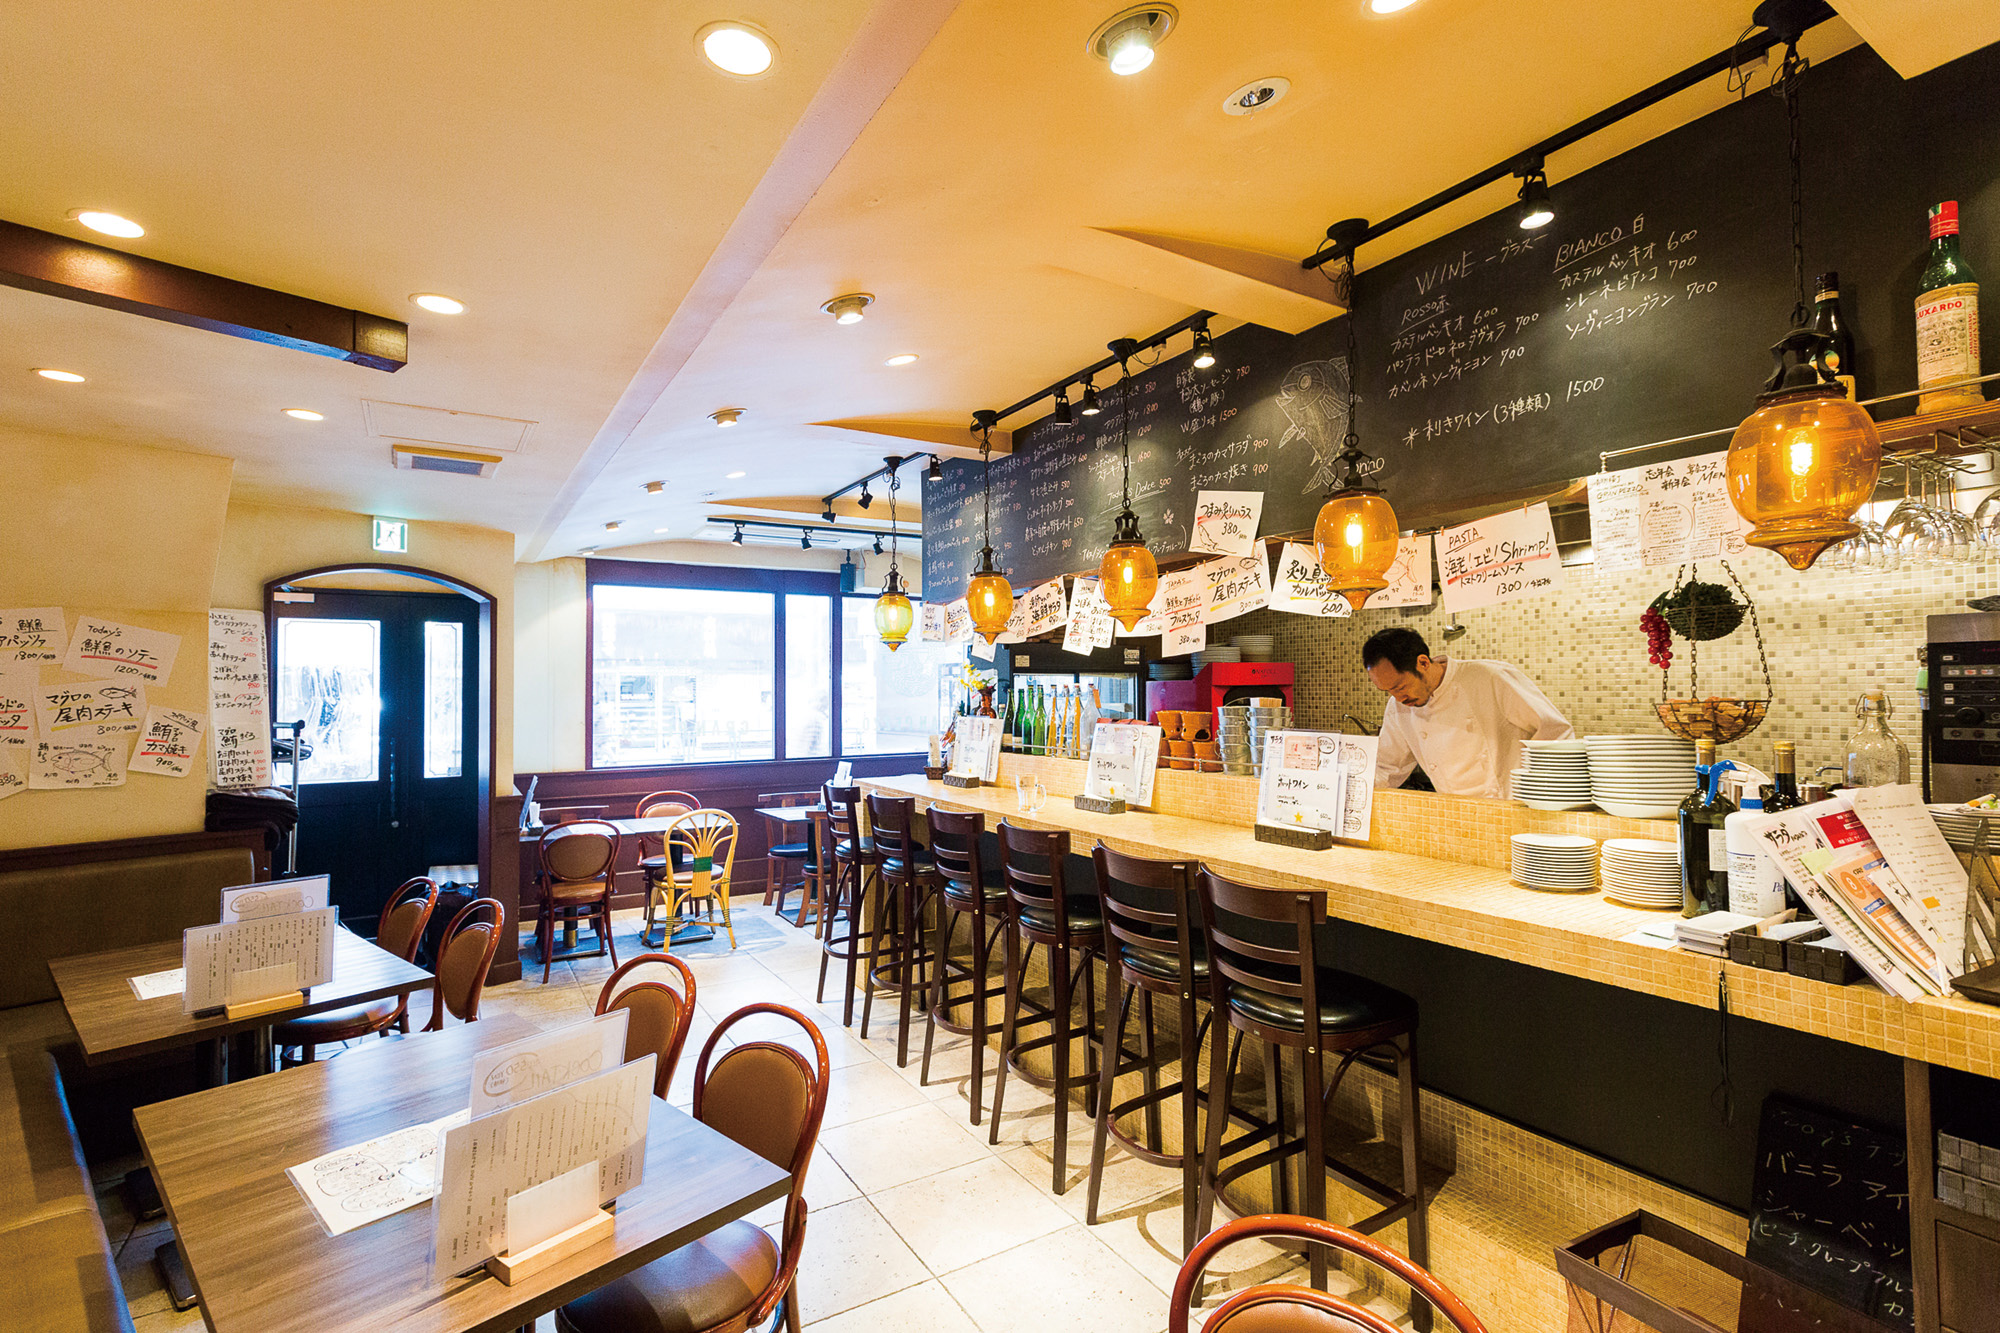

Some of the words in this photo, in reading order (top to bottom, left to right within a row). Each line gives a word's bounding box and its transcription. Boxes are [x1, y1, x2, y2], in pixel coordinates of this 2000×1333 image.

[1555, 226, 1622, 268] BIANCO
[1633, 212, 1644, 234] 白
[1667, 229, 1697, 251] 600
[1416, 251, 1476, 295] WINE
[1669, 256, 1697, 279] 700
[1686, 281, 1718, 300] 700
[1473, 307, 1498, 326] 600
[1515, 312, 1539, 334] 700
[1500, 346, 1525, 367] 700
[1236, 365, 1250, 381] 780
[1567, 377, 1605, 402] 1500
[1143, 402, 1158, 416] 1800
[1219, 407, 1237, 422] 1500
[1252, 438, 1269, 452] 900
[1189, 463, 1248, 492] まぐろのカマ焼き
[1252, 463, 1269, 479] 900
[1645, 465, 1674, 482] 忘年会
[1135, 480, 1156, 498] Dolce
[1159, 477, 1172, 489] 500
[1661, 476, 1691, 491] 新年会
[1073, 516, 1084, 528] 650
[1448, 527, 1480, 549] PASTA
[1207, 566, 1237, 584] マグロの
[1212, 572, 1262, 602] 尾肉ステーキ
[1321, 602, 1343, 615] 600
[87, 624, 122, 640] Today's
[46, 690, 92, 706] マグロの
[54, 702, 133, 724] 尾肉ステーキ
[146, 741, 187, 757] カマ焼き
